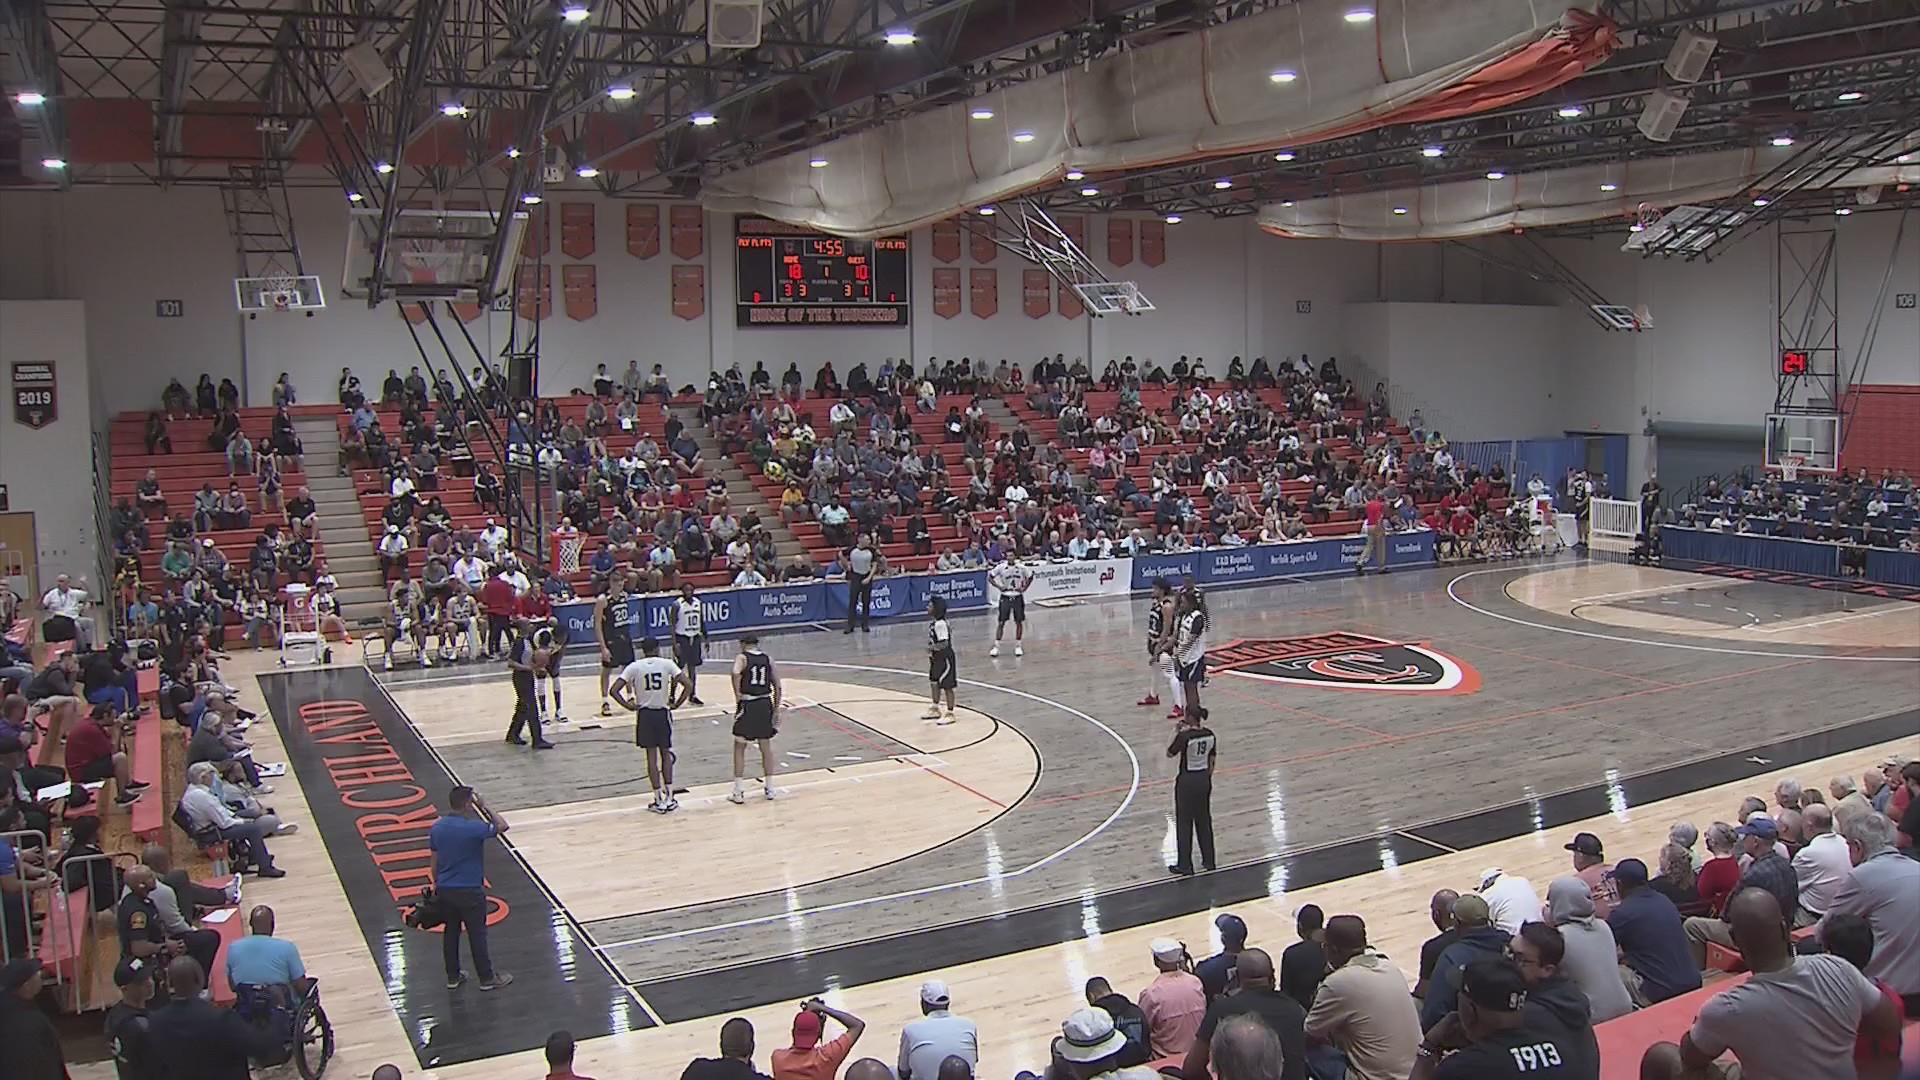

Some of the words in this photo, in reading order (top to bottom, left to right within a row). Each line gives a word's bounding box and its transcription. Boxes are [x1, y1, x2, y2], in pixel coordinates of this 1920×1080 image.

[813, 240, 843, 256] 4:55
[787, 264, 802, 280] 18
[855, 265, 868, 280] 10
[784, 283, 793, 297] 3
[799, 283, 808, 297] 3
[844, 284, 853, 297] 3
[161, 301, 180, 315] 101
[750, 308, 786, 323] HOME
[788, 308, 805, 323] OF
[807, 308, 832, 322] THE
[834, 307, 898, 322] TRUCKERS
[1783, 352, 1806, 374] 24
[18, 391, 51, 405] 2019
[1306, 550, 1318, 561] Club
[1065, 564, 1097, 575] Invitational
[1142, 567, 1157, 578] Sales
[930, 580, 949, 592] Roger
[951, 579, 975, 590] Browns
[1048, 576, 1081, 586] Tournament
[760, 592, 779, 605] Mike
[780, 592, 808, 604] Duman
[956, 588, 973, 600] Sports
[294, 596, 305, 609] G
[876, 598, 892, 609] Club
[614, 607, 629, 623] 20
[763, 604, 781, 617] Auto
[782, 603, 803, 616] Sales
[568, 617, 585, 632] City
[585, 614, 595, 629] of
[686, 614, 699, 627] 10
[643, 672, 663, 691] 15
[749, 664, 767, 686] 11
[1196, 740, 1208, 756] 19
[1509, 1042, 1563, 1072] 1913
